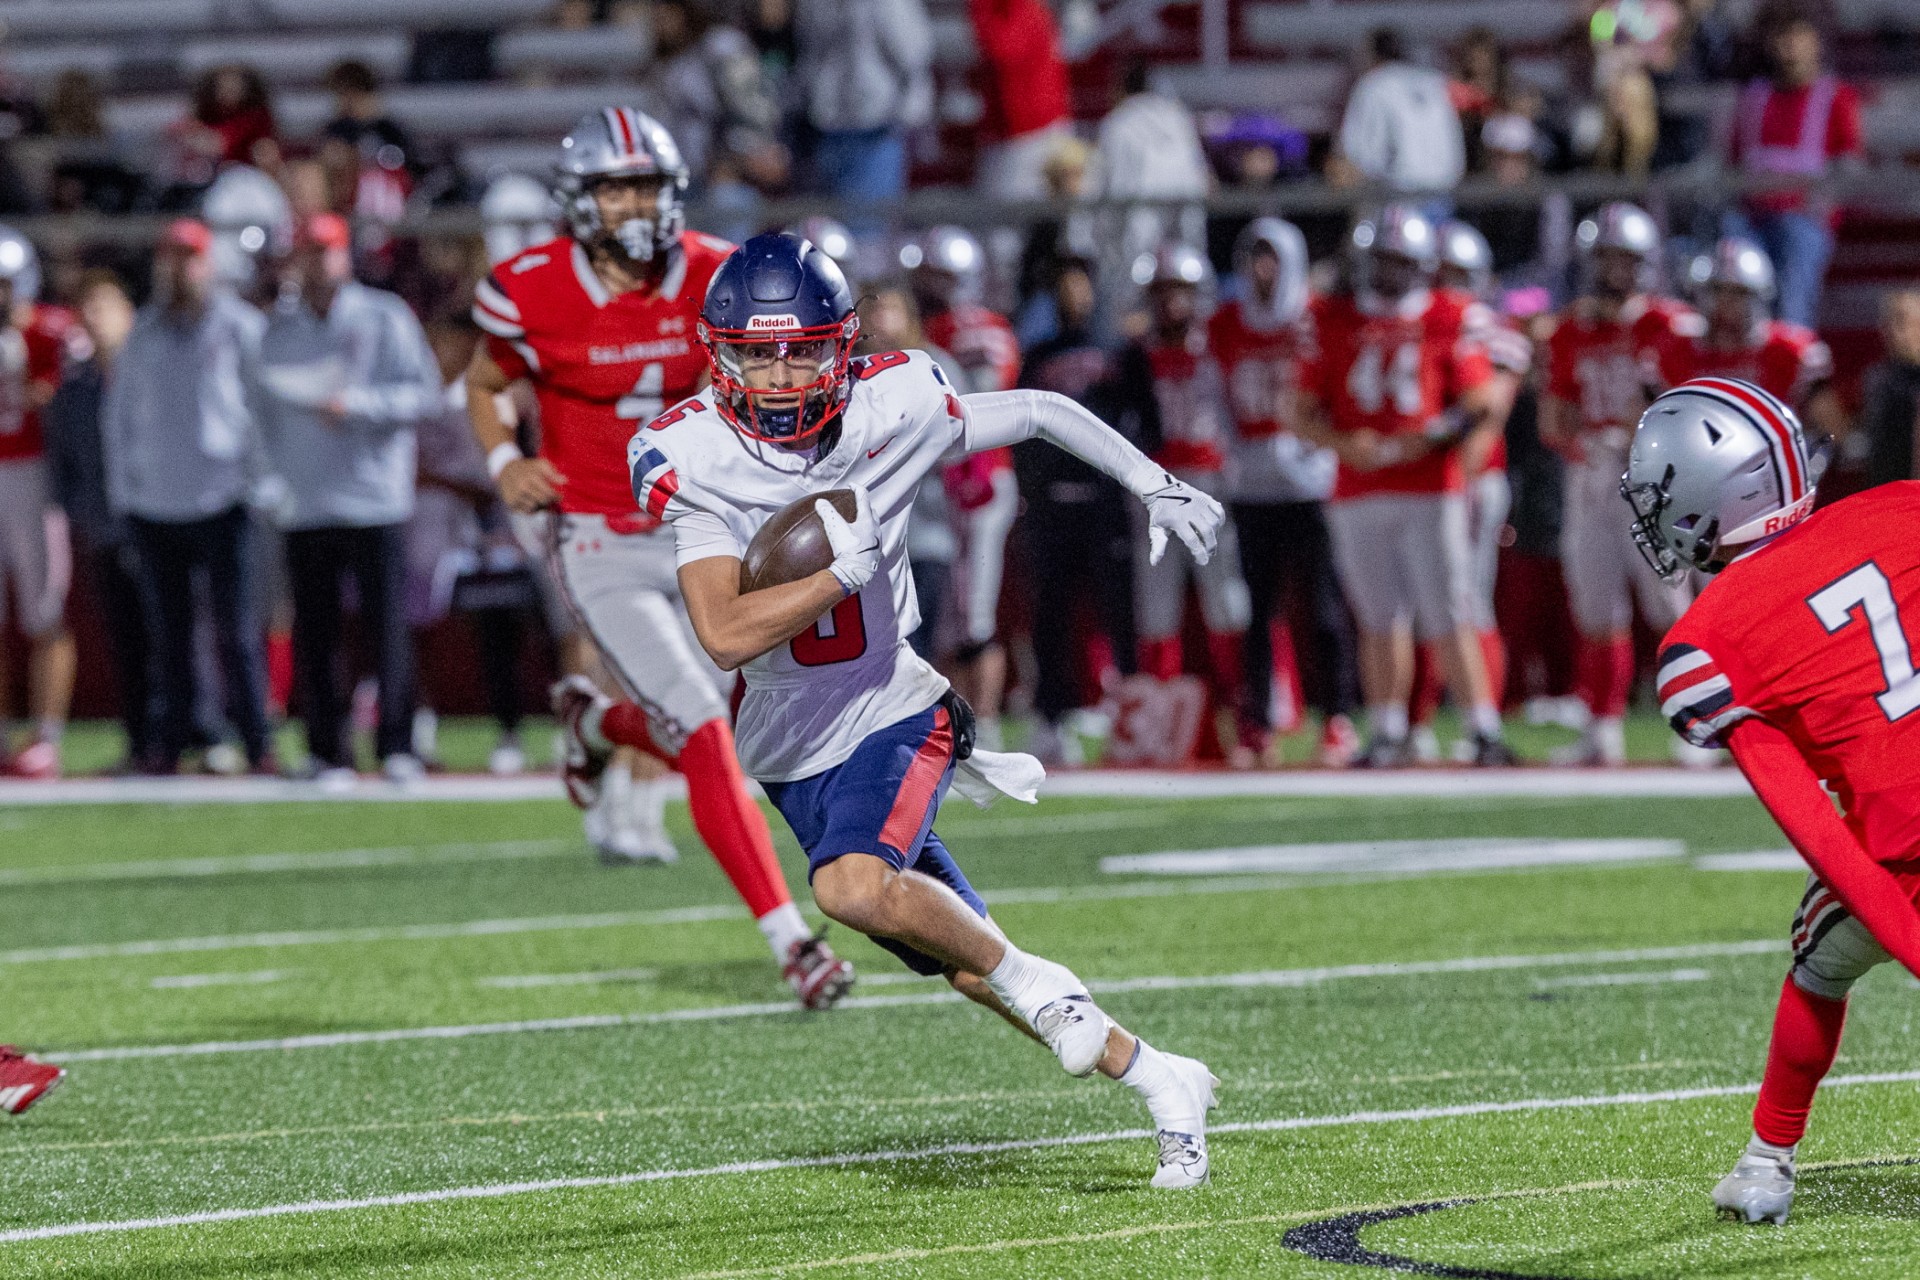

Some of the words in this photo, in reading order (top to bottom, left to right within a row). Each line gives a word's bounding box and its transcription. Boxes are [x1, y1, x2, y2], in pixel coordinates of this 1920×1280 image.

[752, 317, 795, 328] Riddell
[615, 361, 665, 430] 4
[1347, 344, 1422, 414] 44
[646, 398, 708, 432] 6
[1804, 558, 1920, 722] 7
